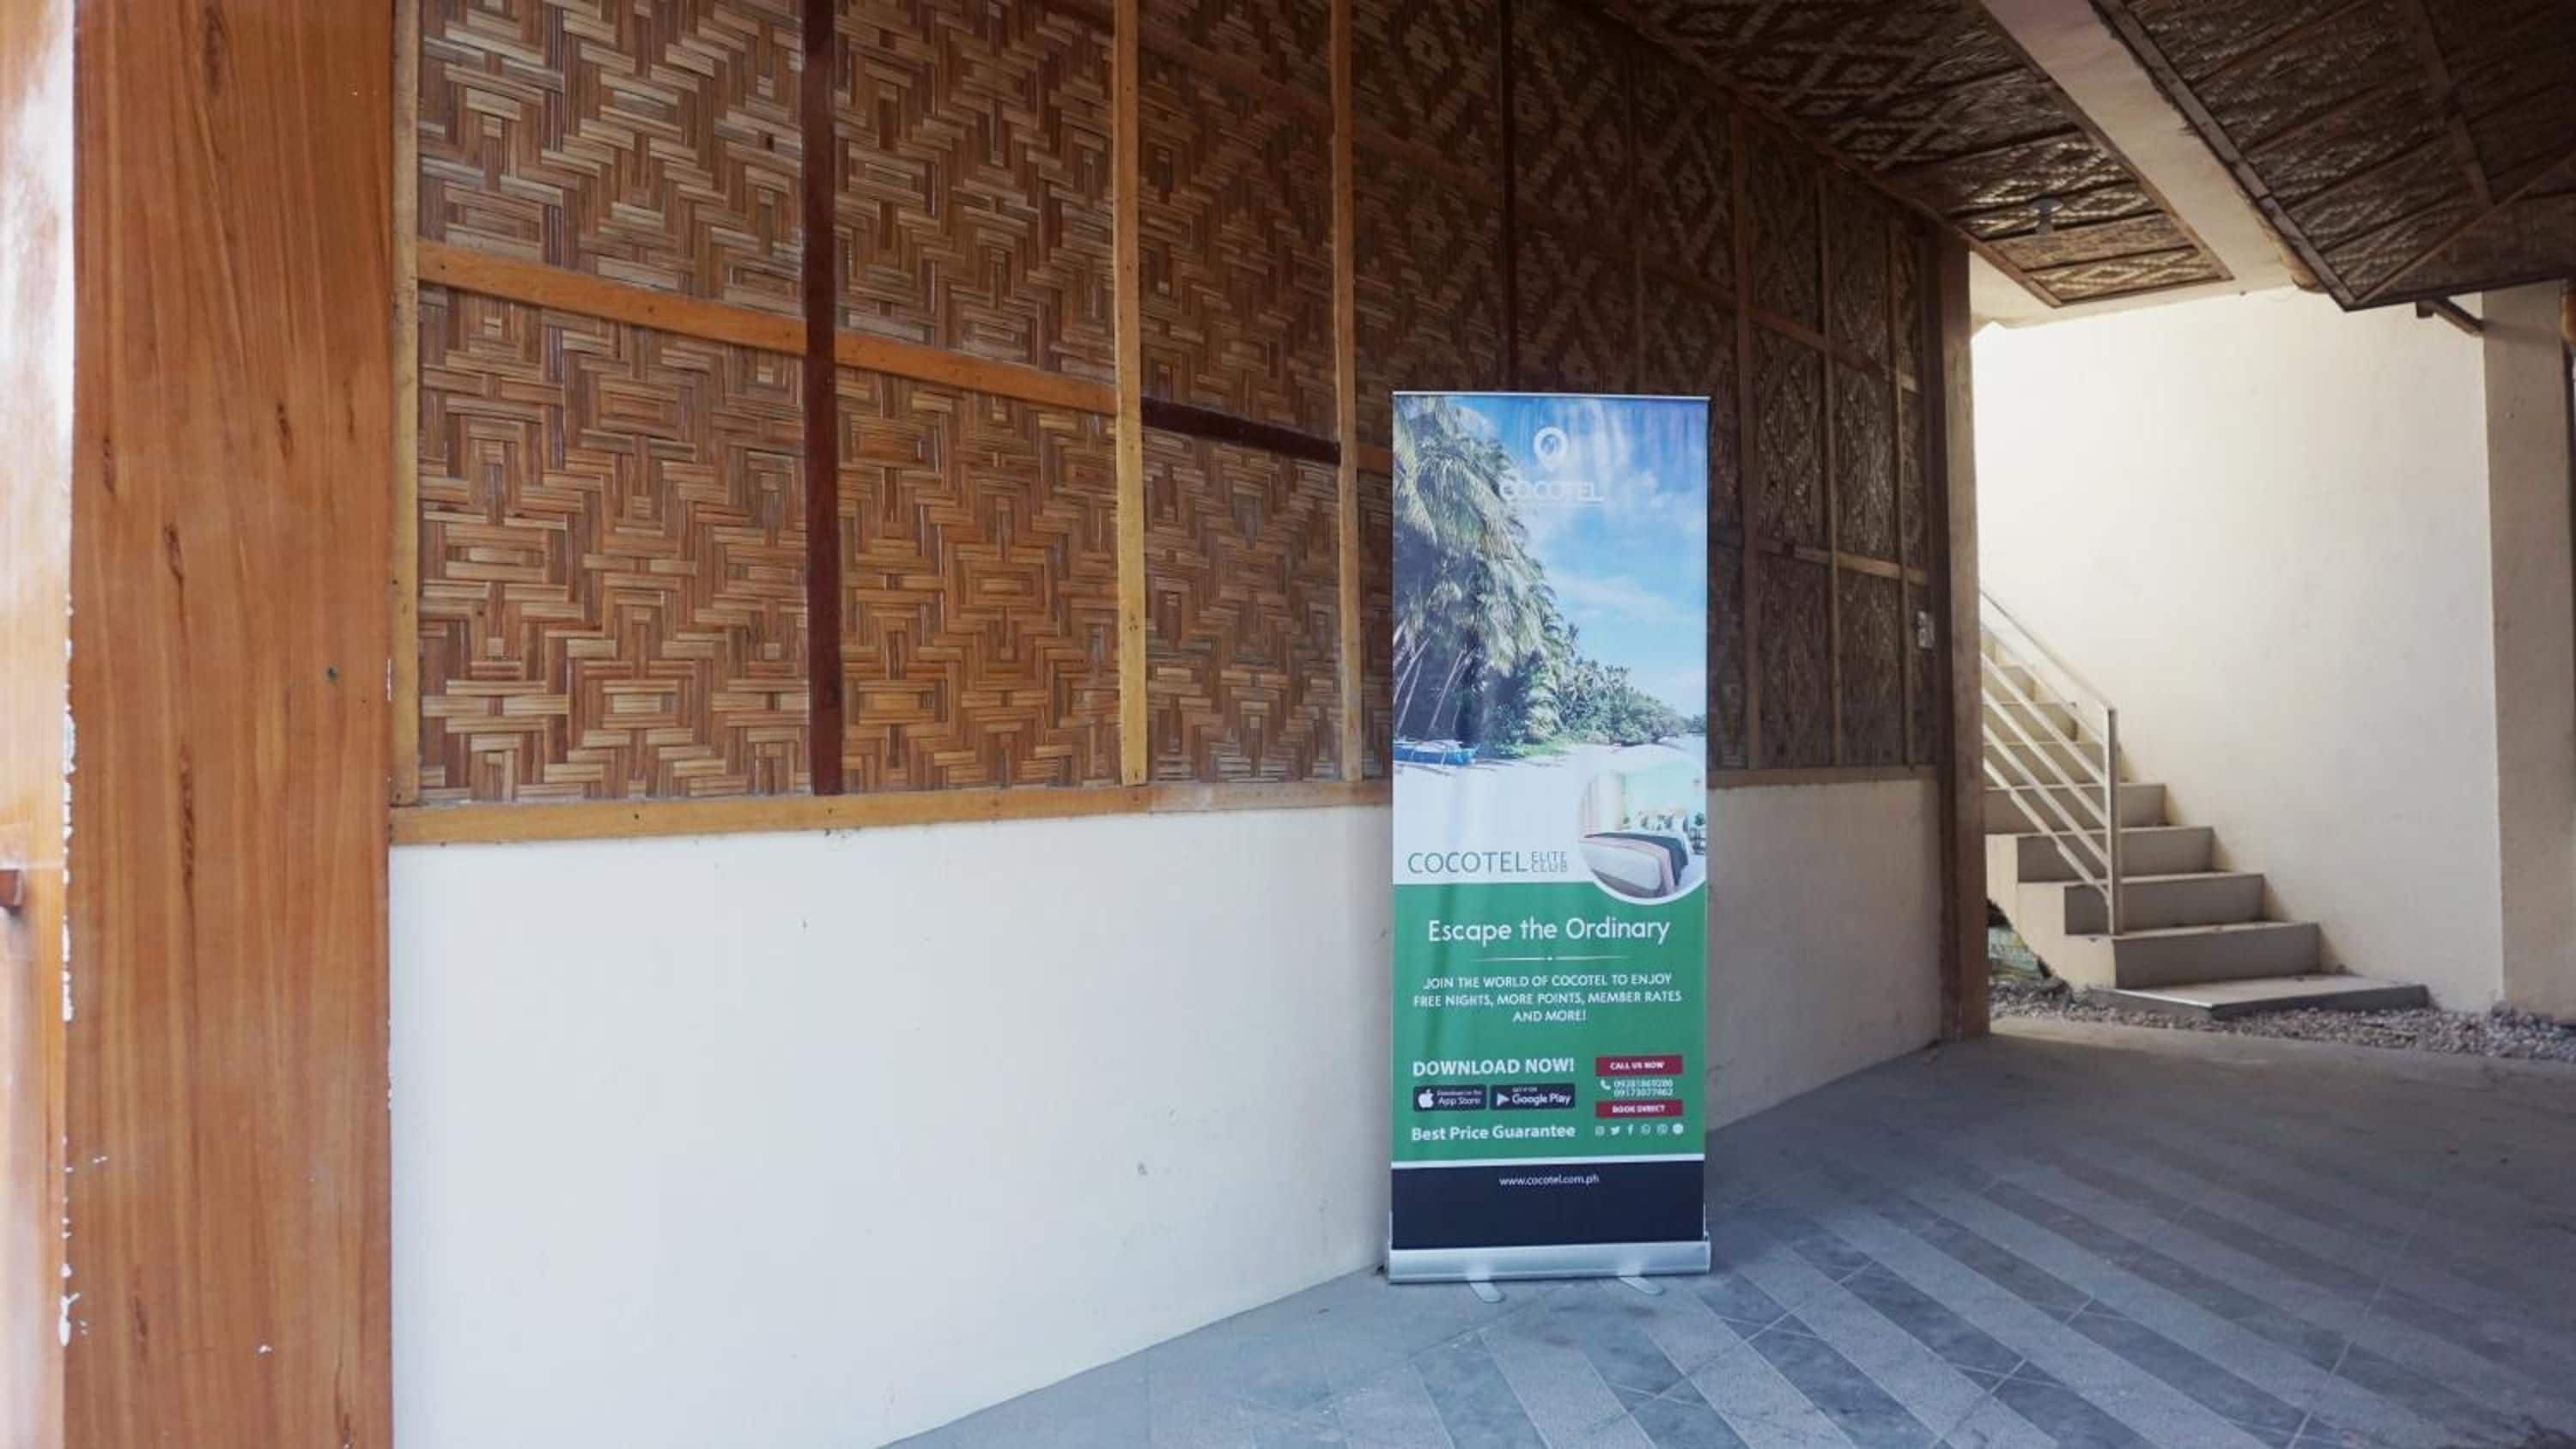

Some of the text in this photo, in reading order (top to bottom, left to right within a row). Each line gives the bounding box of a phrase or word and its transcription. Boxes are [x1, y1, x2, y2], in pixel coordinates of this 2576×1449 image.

[1499, 481, 1604, 501] COCOTEL
[1407, 851, 1528, 874] COCOTEL
[1531, 851, 1567, 861] ELITE
[1531, 862, 1568, 873] CLUB
[1428, 916, 1671, 947] Escape the Ordinary
[1424, 973, 1672, 989] JOIN THE WORLD OF COCOTEL TO ENJOY
[1413, 991, 1682, 1008] FREE NIGHTS, MORE POINTS, MEMBER RATES
[1512, 1009, 1586, 1022] AND MORE!
[1413, 1058, 1574, 1076] DOWNLOAD NOW!
[1609, 1062, 1630, 1070] CALL
[1438, 1096, 1480, 1106] App Store
[1511, 1092, 1572, 1106] Google Play
[1613, 1105, 1635, 1113] BOOK
[1412, 1125, 1576, 1140] Best Price Guarantee
[1498, 1174, 1600, 1186] www.cocotel.com.ph
